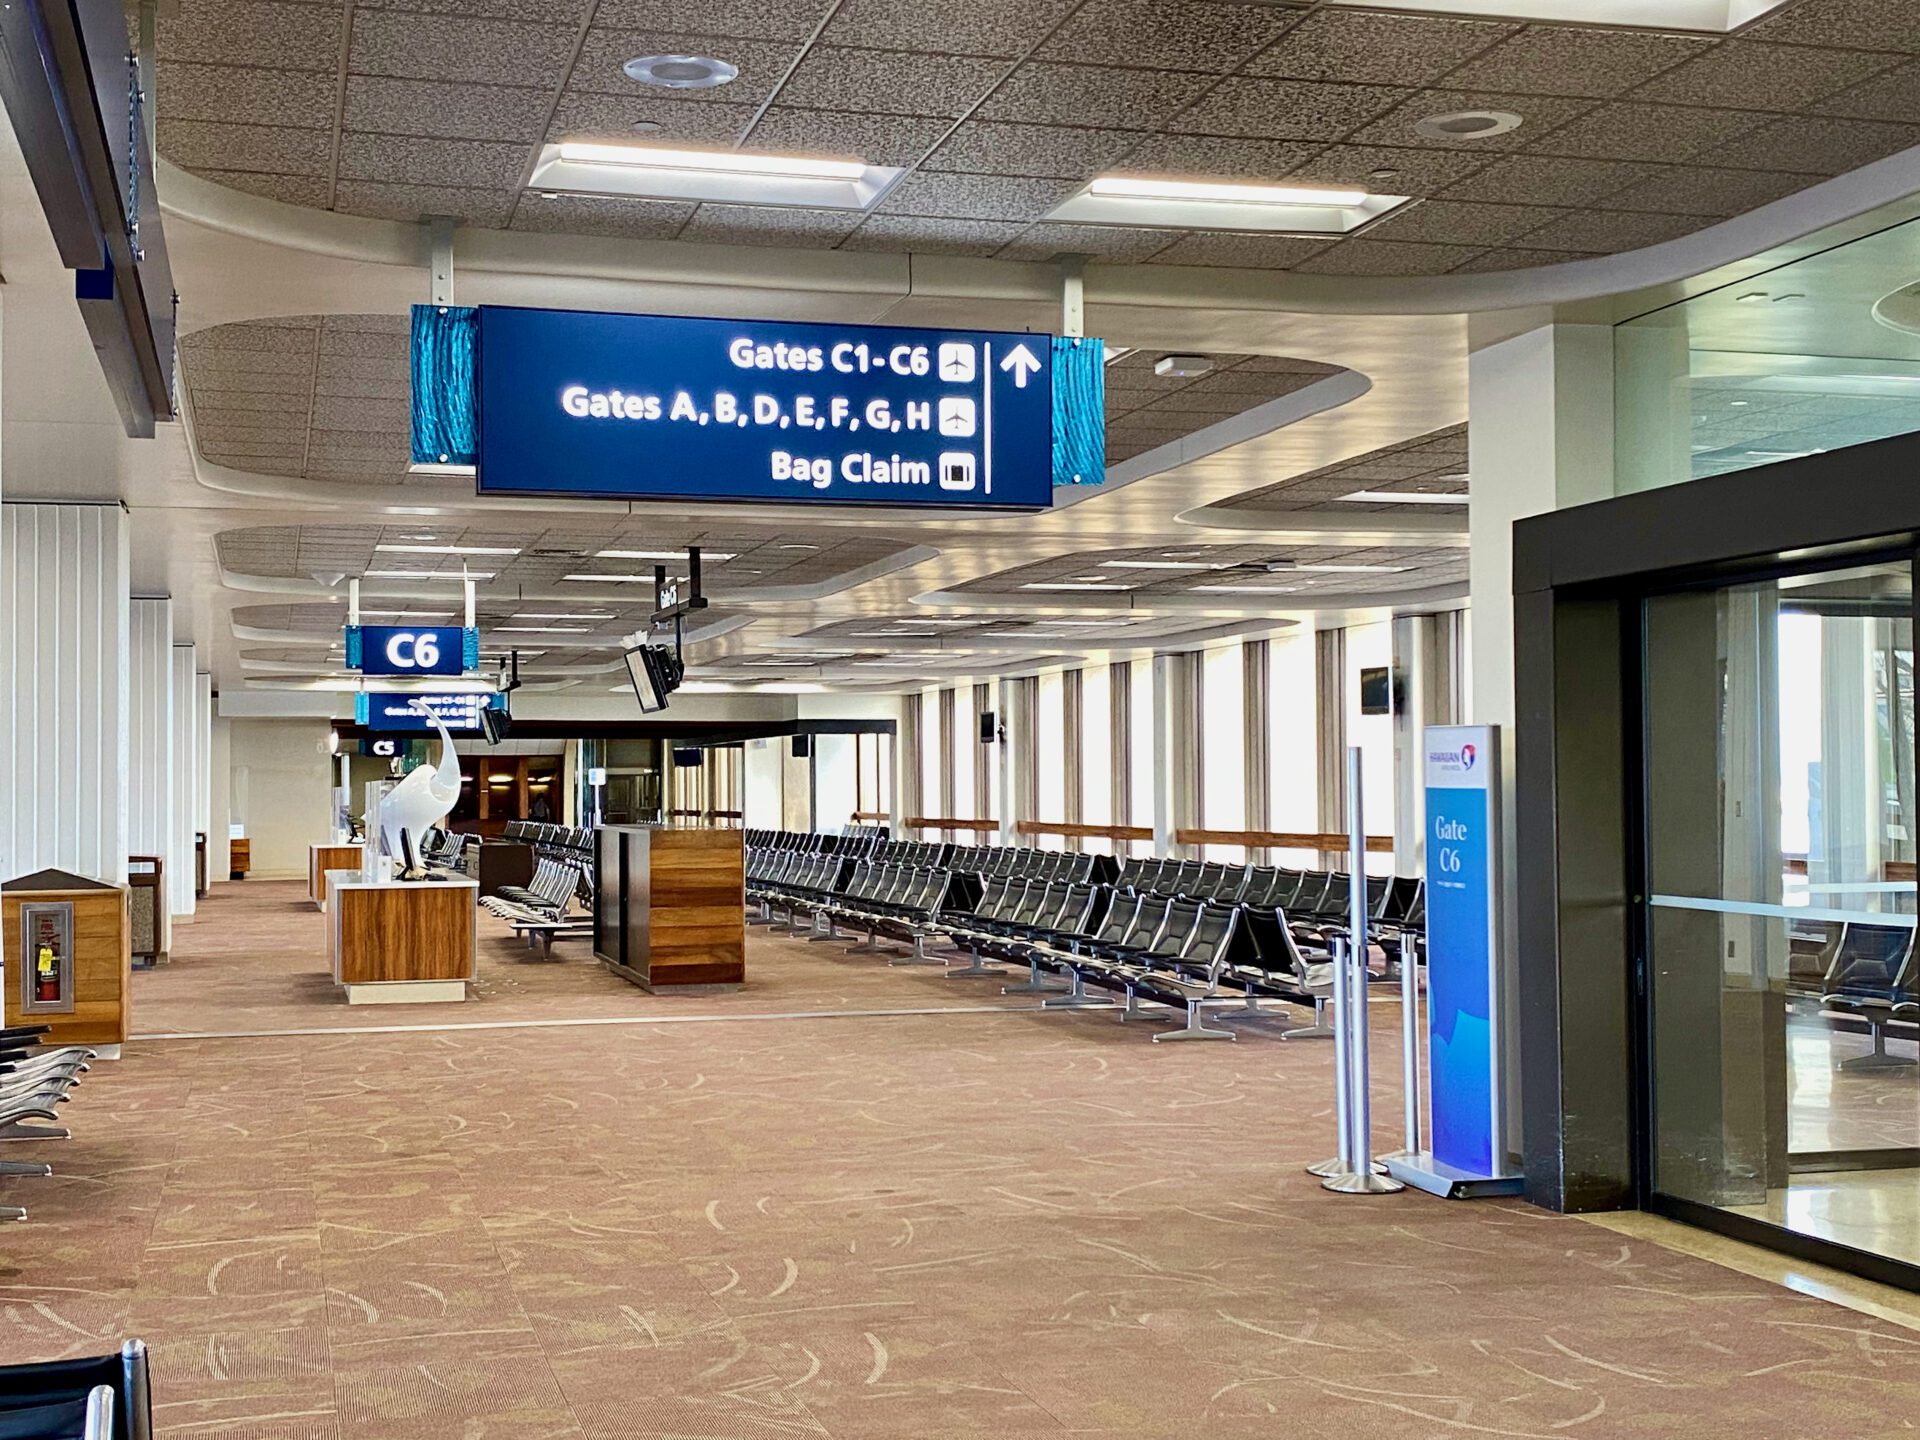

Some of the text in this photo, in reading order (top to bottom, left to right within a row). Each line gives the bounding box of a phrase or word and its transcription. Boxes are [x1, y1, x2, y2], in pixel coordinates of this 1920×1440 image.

[729, 337, 930, 376] Gates C1-C6
[561, 385, 662, 420] Gates
[771, 451, 930, 489] Bag Claim
[386, 633, 440, 668] C6
[373, 740, 395, 756] C5
[1435, 815, 1468, 841] Gate
[1439, 847, 1461, 873] C6
